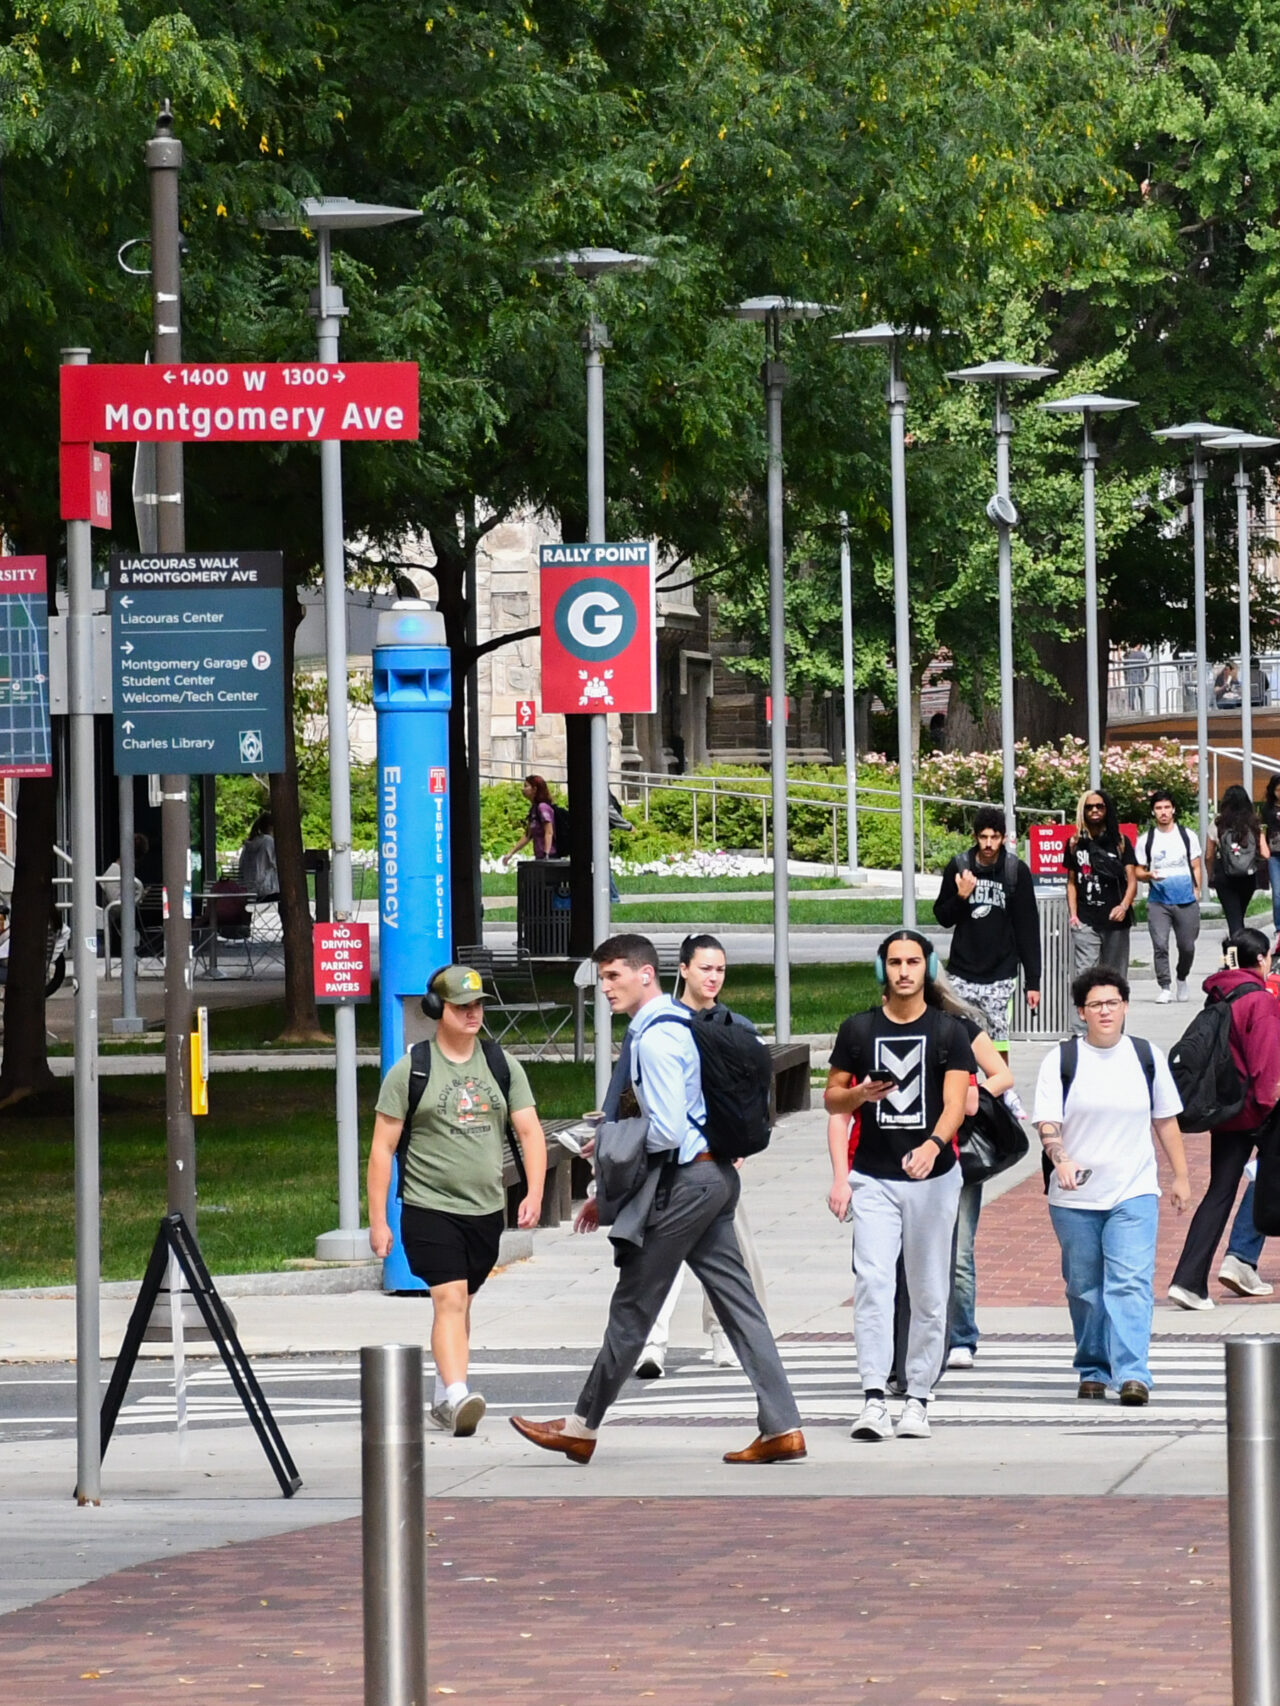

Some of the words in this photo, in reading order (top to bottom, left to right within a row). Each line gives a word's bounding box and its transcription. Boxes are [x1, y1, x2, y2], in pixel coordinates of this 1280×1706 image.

[180, 368, 229, 385] 1400
[243, 371, 266, 391] W
[282, 368, 329, 385] 1300
[105, 402, 325, 438] Montgomery
[341, 402, 404, 430] Ave
[543, 548, 591, 562] RALLY
[595, 547, 647, 562] POINT
[120, 558, 196, 570] LIACOURAS
[199, 557, 239, 569] WALK
[120, 572, 129, 584] &
[132, 571, 228, 583] MONTGOMERY
[231, 570, 258, 582] AVE
[120, 613, 179, 624] Liacouras
[182, 612, 224, 623] Center
[567, 591, 623, 647] G
[121, 659, 200, 671] Montgomery
[203, 658, 248, 670] Garage
[257, 654, 267, 667] P
[122, 675, 170, 686] Student
[174, 675, 215, 686] Center
[122, 690, 214, 703] Welcome/Tech
[217, 690, 259, 702] Center
[122, 738, 168, 749] Charles
[171, 737, 215, 750] Library
[434, 798, 444, 863] TEMPLE
[383, 766, 401, 929] Emergency
[1039, 841, 1063, 851] 1810
[436, 874, 444, 939] POLICE
[333, 929, 350, 938] NO
[321, 939, 362, 949] DRIVING
[334, 950, 349, 960] OR
[321, 961, 363, 970] PARKING
[333, 972, 351, 981] ON
[325, 982, 360, 992] PAVERS
[437, 1084, 453, 1115] SLOW
[881, 1111, 921, 1124] hummel
